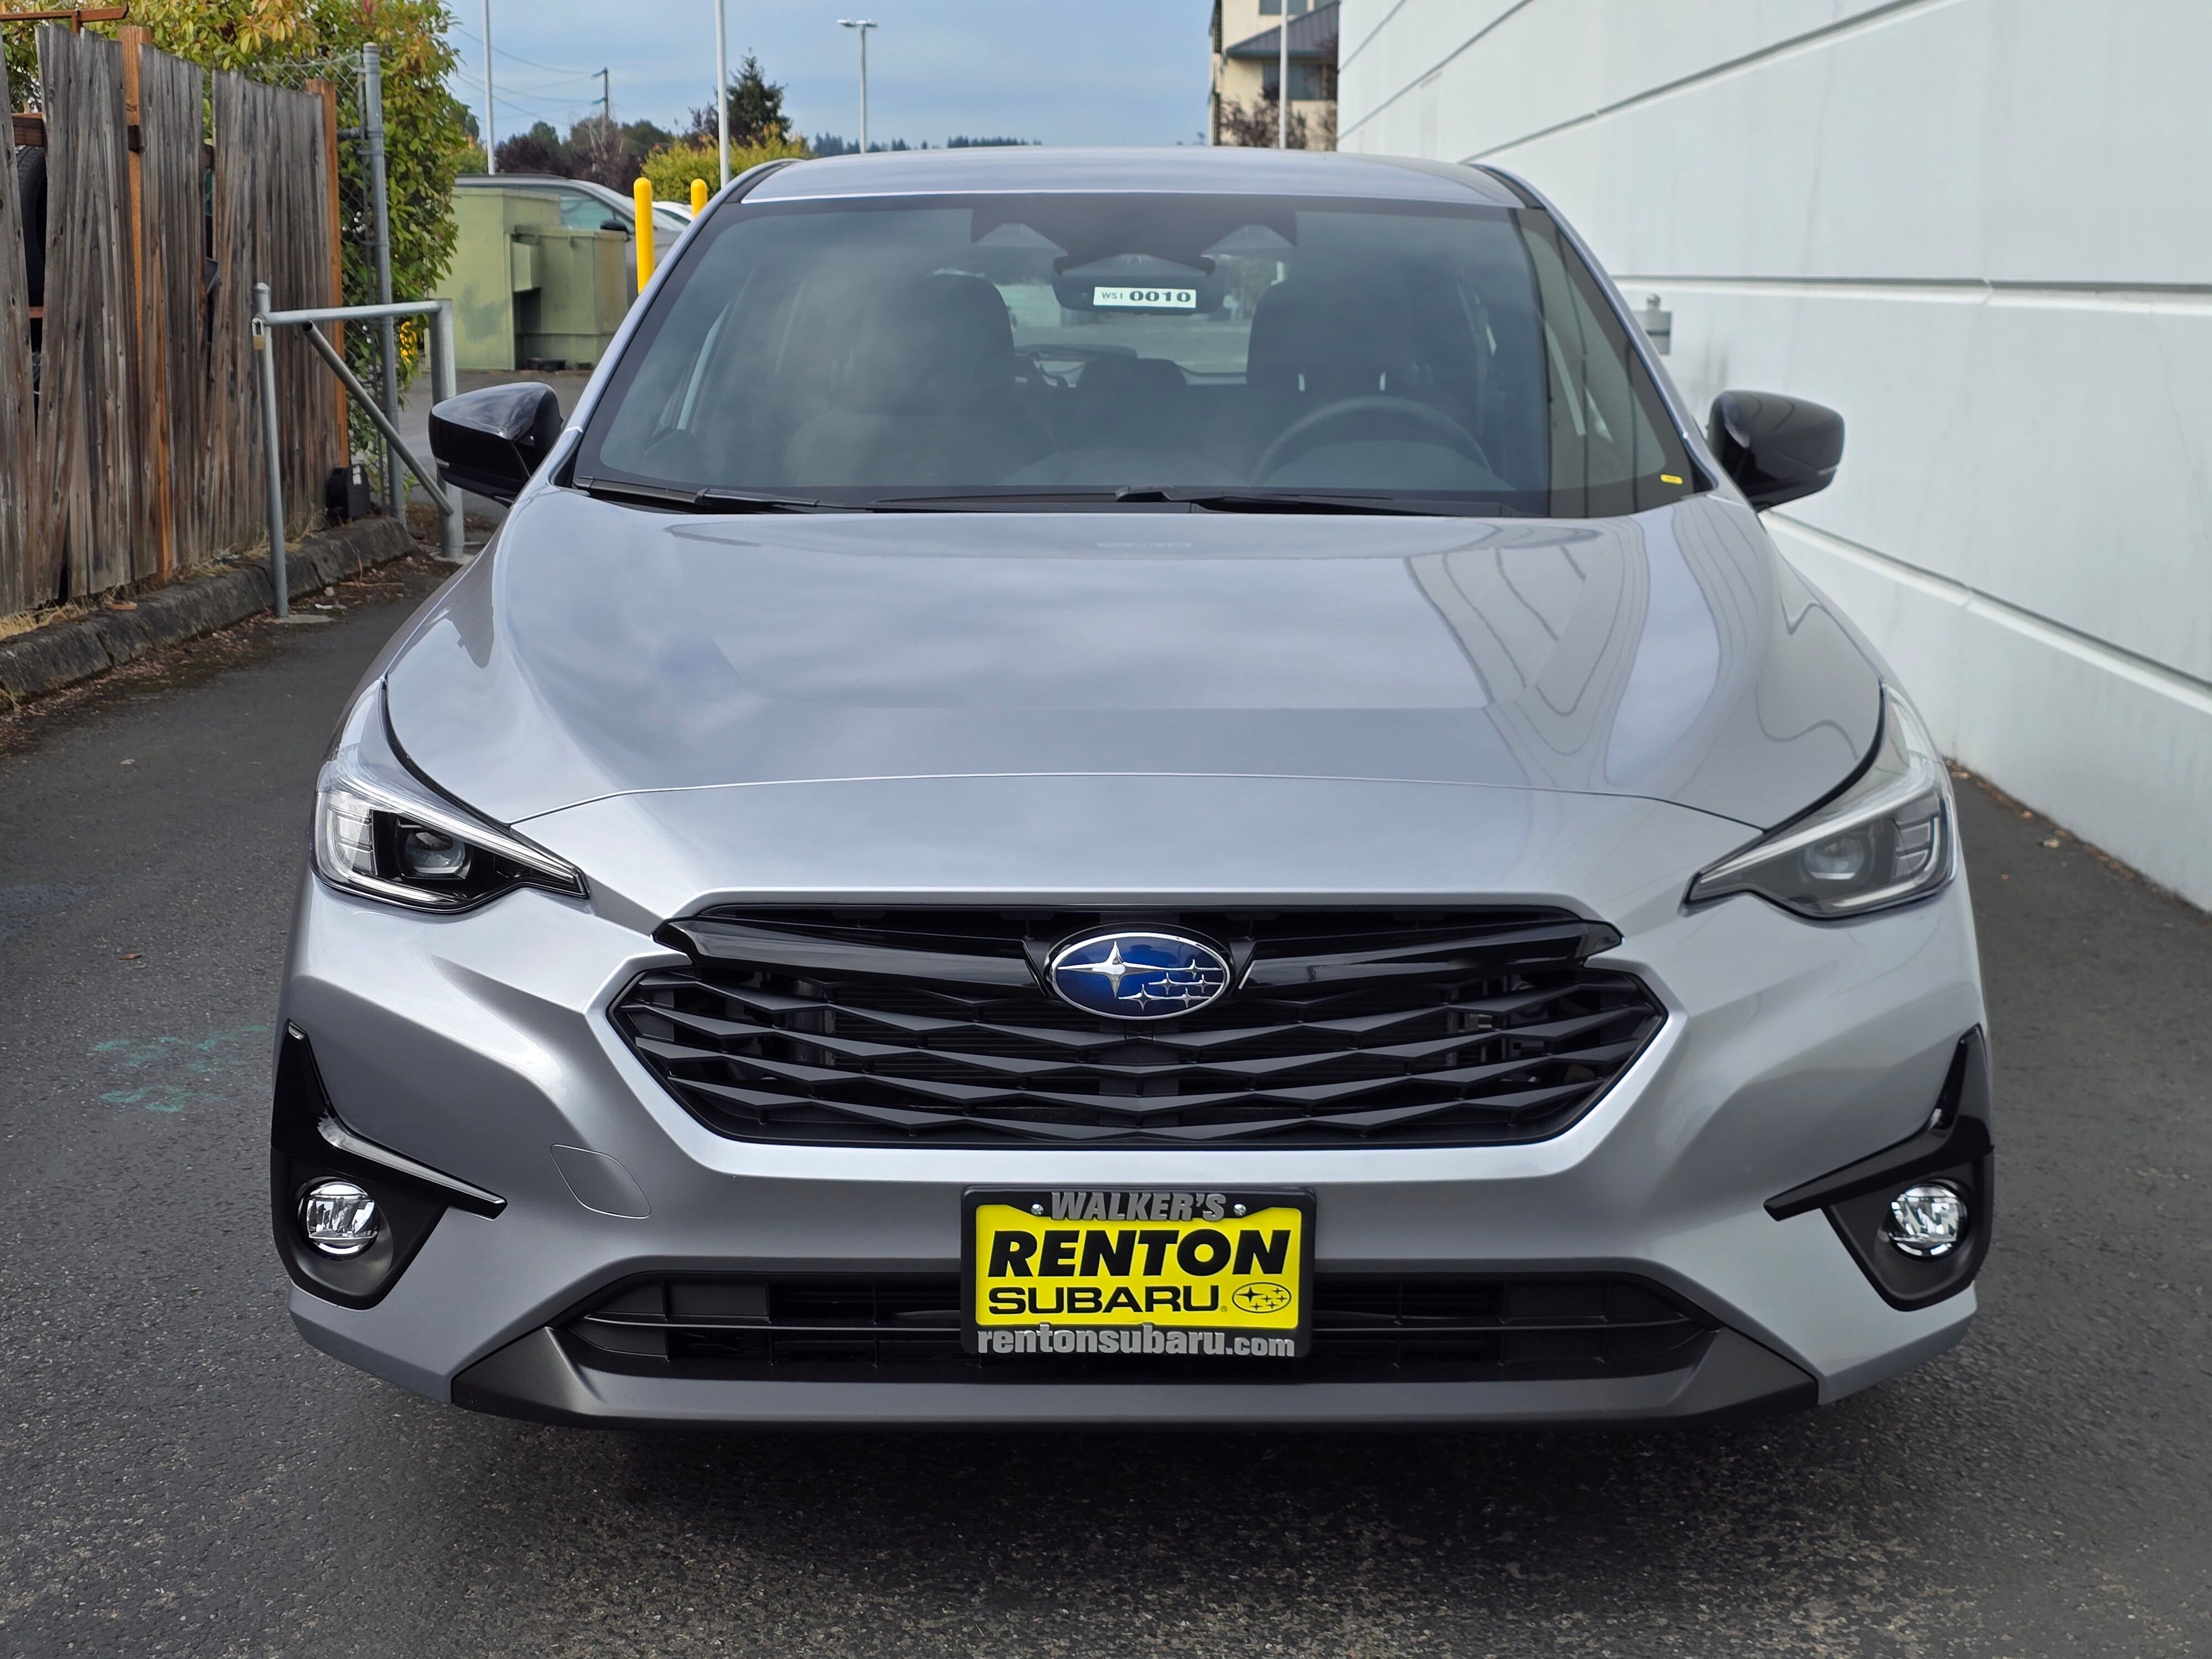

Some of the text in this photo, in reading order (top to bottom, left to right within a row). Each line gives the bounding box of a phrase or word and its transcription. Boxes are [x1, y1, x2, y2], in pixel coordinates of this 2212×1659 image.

[1129, 290, 1191, 302] 0010
[1051, 1191, 1226, 1222] WALKER'S
[988, 1229, 1291, 1277] RENTON
[989, 1285, 1220, 1314] SUBARU
[978, 1322, 1295, 1357] rentonsubaru.com
